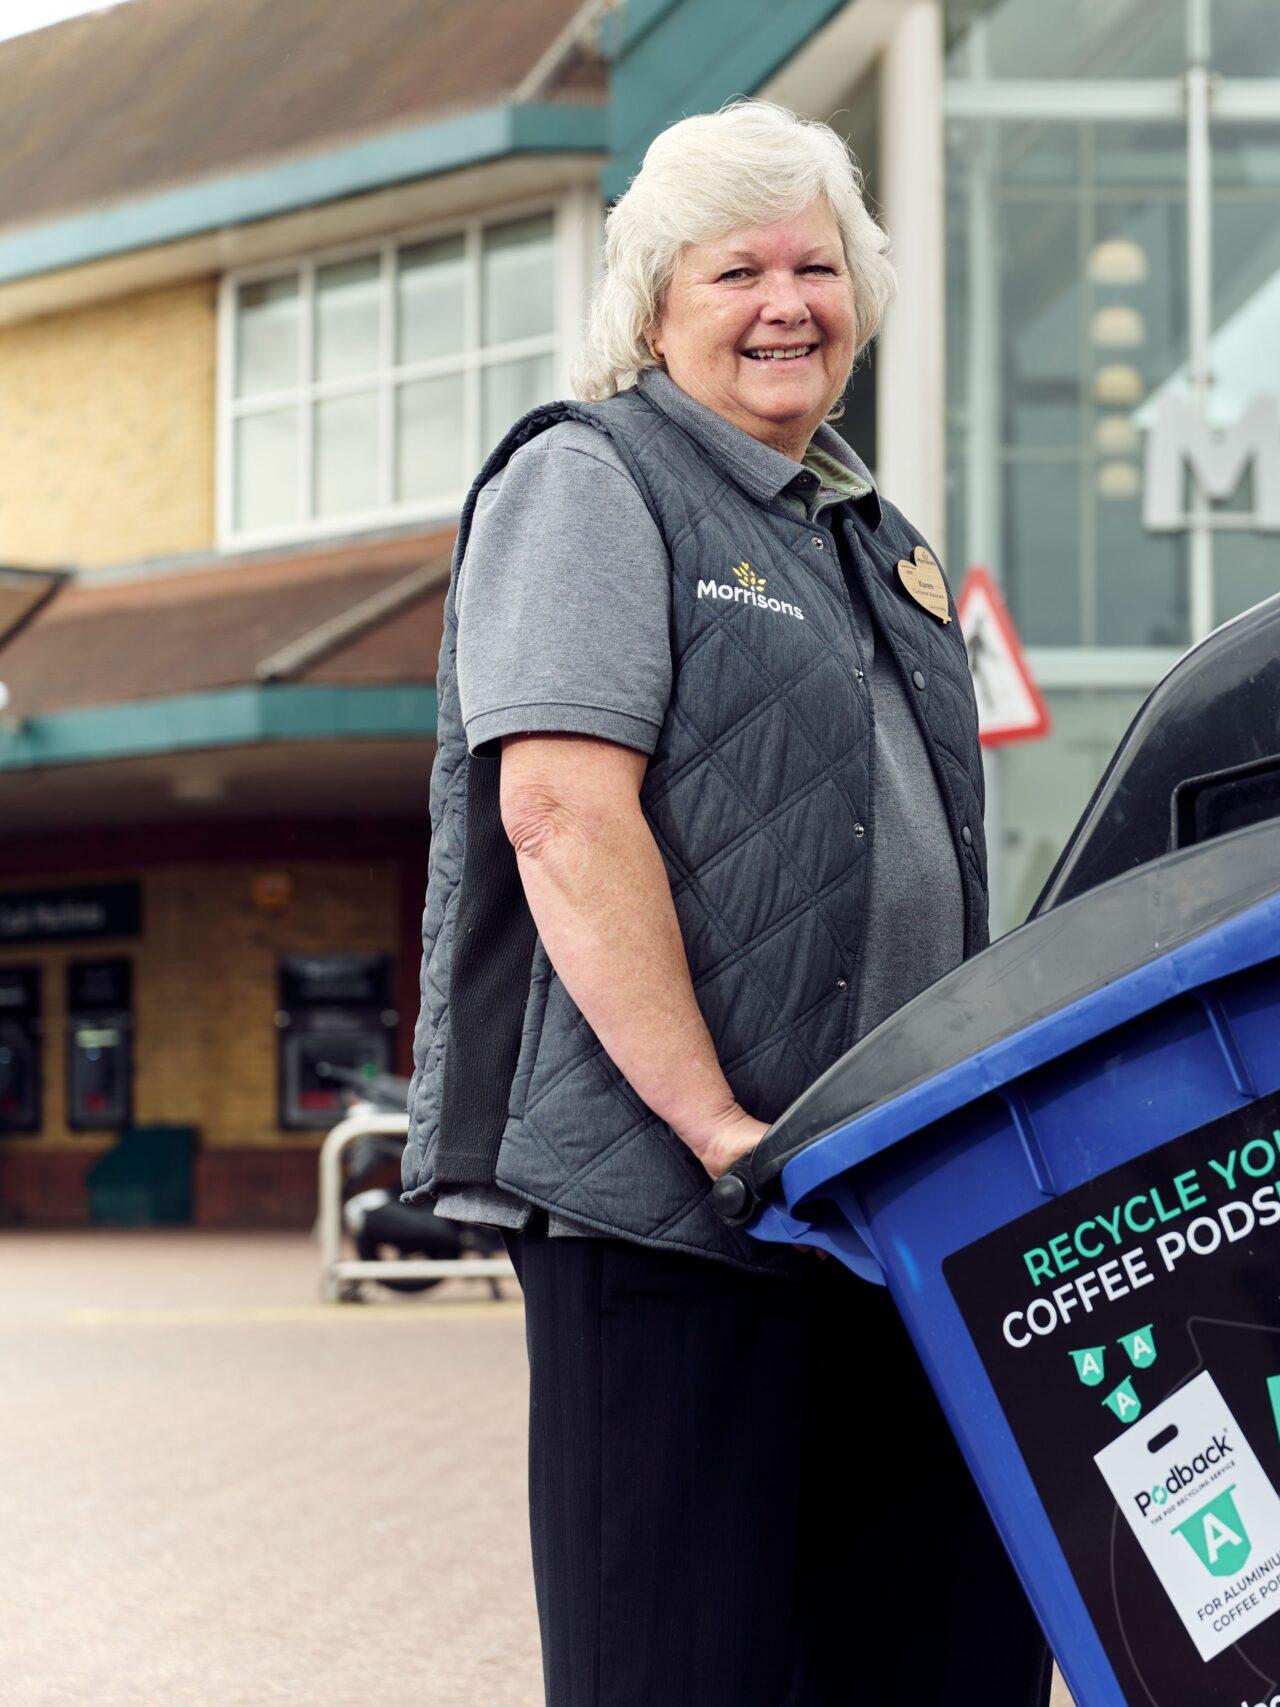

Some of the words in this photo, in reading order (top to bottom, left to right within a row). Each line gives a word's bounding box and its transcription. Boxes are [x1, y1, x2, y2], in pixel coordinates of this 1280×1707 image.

[697, 580, 804, 620] Morrisons
[1023, 1169, 1207, 1287] RECYCLE
[1003, 1247, 1155, 1348] COFFEE
[1134, 1435, 1233, 1517] Podback
[1202, 1512, 1243, 1564] A
[1197, 1598, 1223, 1621] FOR
[1213, 1594, 1259, 1632] COFFEE
